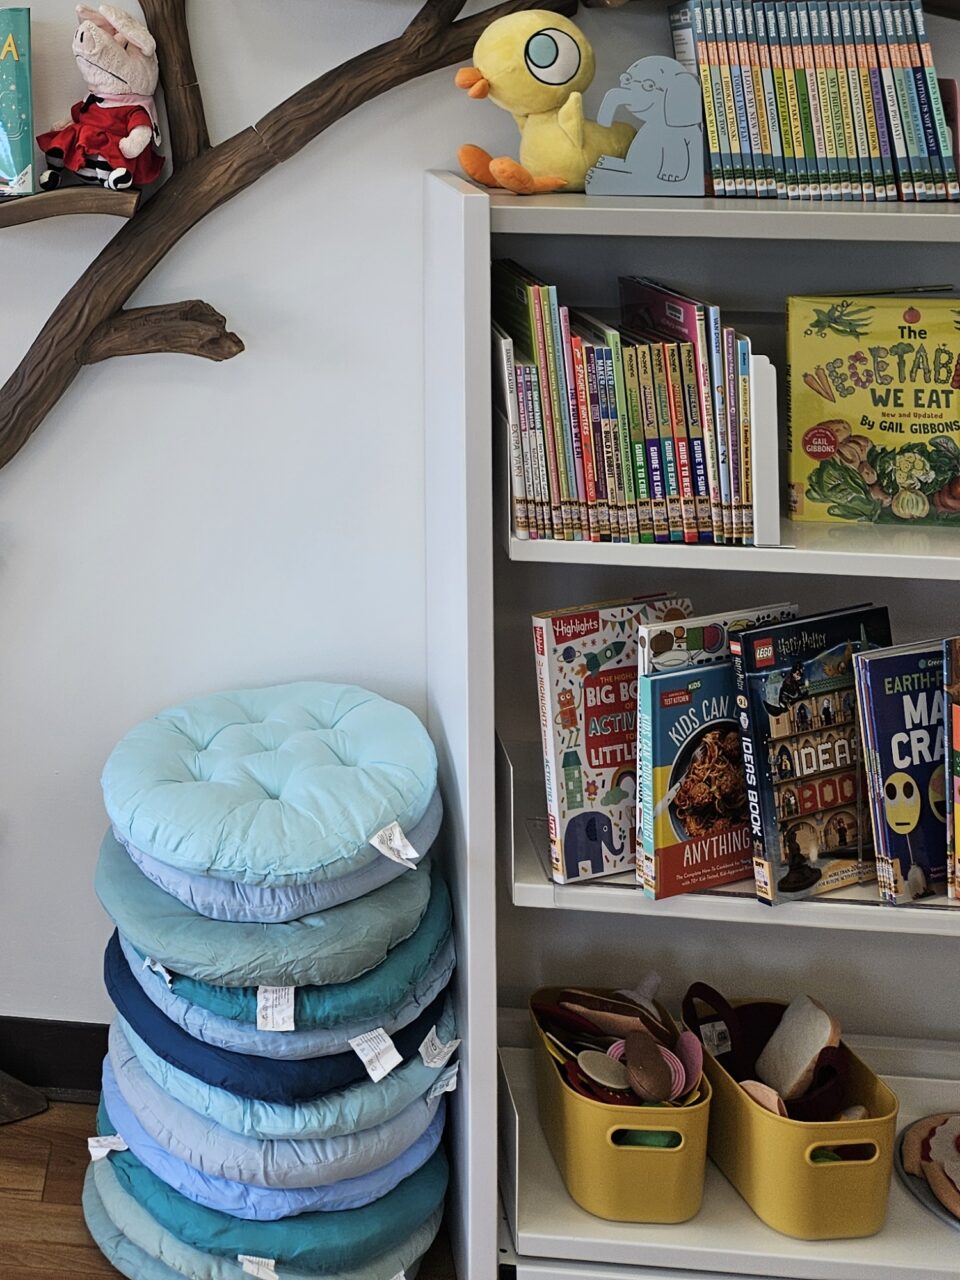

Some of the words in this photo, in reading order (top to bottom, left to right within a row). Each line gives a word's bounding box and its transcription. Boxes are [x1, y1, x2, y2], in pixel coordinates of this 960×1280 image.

[829, 77, 836, 88] MY
[861, 74, 869, 88] THE
[831, 91, 840, 120] FRIEND
[863, 90, 872, 113] THANK
[886, 84, 895, 108] HAPPY
[915, 72, 926, 103] WAITING
[923, 113, 931, 127] NOT
[835, 122, 841, 130] IS
[890, 110, 898, 121] PIG
[869, 131, 877, 150] BOOK
[898, 325, 927, 339] The
[575, 364, 585, 401] SPAGHETTI
[687, 383, 699, 427] MINECRAFT
[871, 388, 905, 408] WE
[914, 390, 954, 409] EAT
[860, 415, 875, 429] By
[879, 420, 905, 434] GAIL
[910, 420, 960, 435] GIBBONS
[913, 412, 943, 420] Updated
[512, 424, 521, 451] EXTRA
[603, 430, 611, 448] BUILD
[649, 447, 659, 469] GUIDE
[678, 441, 687, 464] GUIDE
[692, 440, 702, 462] GUIDE
[806, 444, 835, 453] GIBBONS
[514, 453, 522, 477] YARN
[652, 471, 660, 480] TO
[680, 466, 689, 476] TO
[695, 465, 703, 474] TO
[553, 618, 598, 638] Highlights
[755, 645, 773, 660] LEGO
[777, 637, 801, 656] Harry
[801, 631, 827, 650] Potter
[688, 681, 701, 690] KIDS
[538, 676, 547, 727] HIGHLIGHTS
[586, 686, 615, 707] BIG
[676, 696, 689, 704] KITCHEN
[642, 713, 650, 734] KIDS
[668, 708, 700, 747] KIDS
[702, 695, 730, 720] CAN
[643, 738, 651, 755] CAN
[643, 760, 651, 784] COOK
[741, 736, 757, 787] IDEAS
[544, 758, 553, 802] ACTIVITIES
[747, 789, 762, 837] BOOK
[683, 827, 750, 867] ANYTHING
